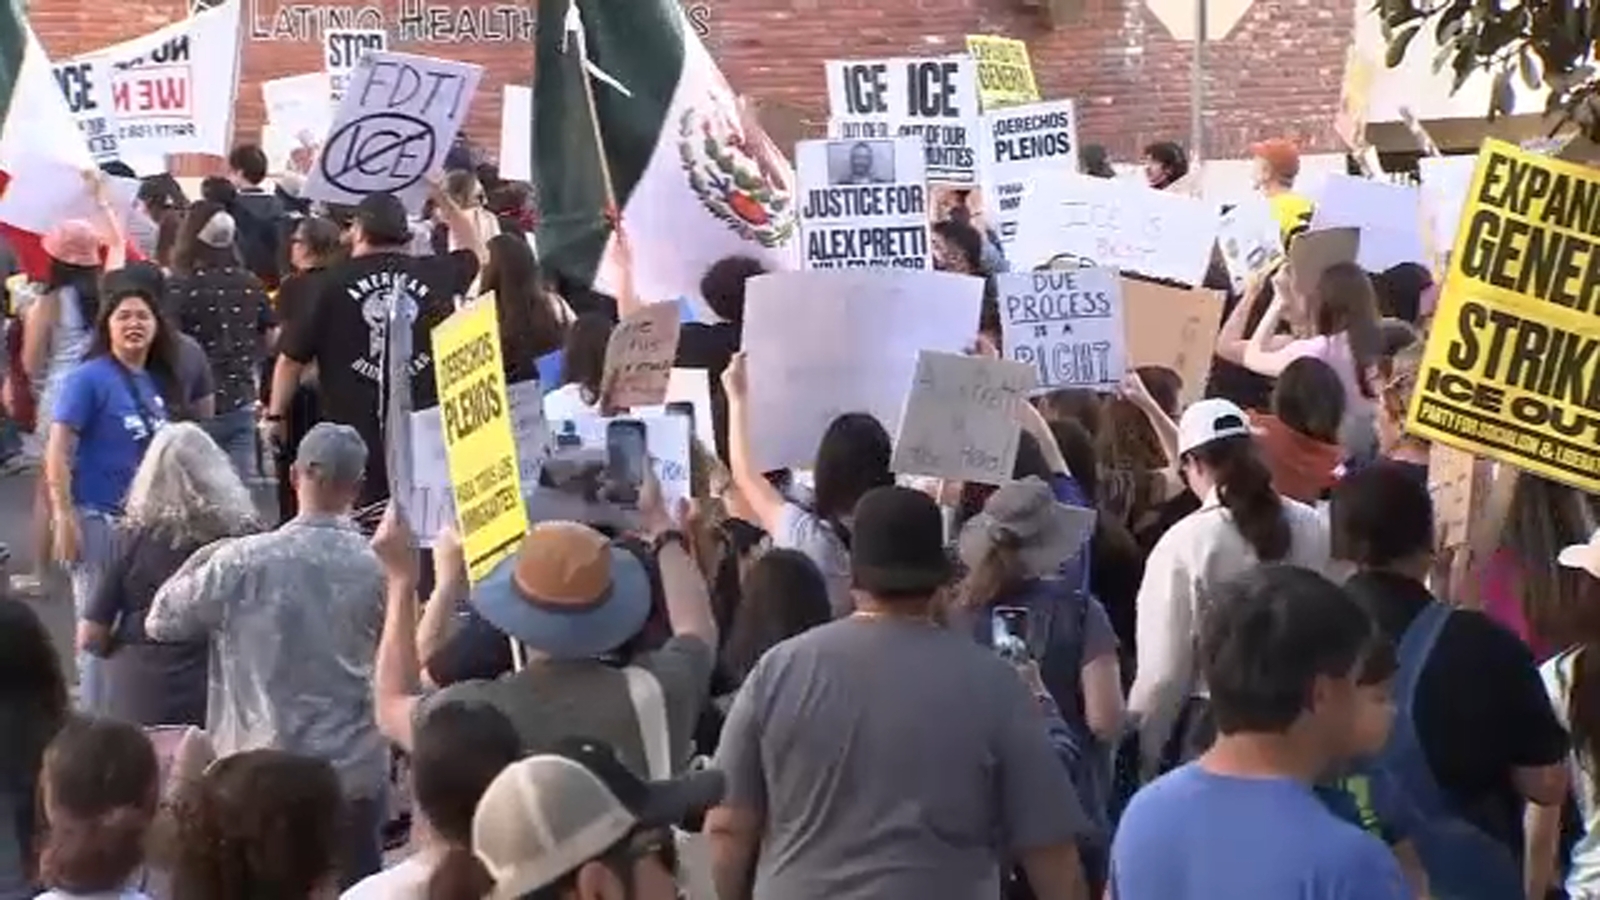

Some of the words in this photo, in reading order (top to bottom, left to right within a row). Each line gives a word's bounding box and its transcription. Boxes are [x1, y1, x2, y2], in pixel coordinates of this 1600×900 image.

[843, 64, 888, 114] ICE
[907, 62, 960, 118] ICE
[352, 124, 425, 179] ICE
[994, 132, 1071, 162] PLENOS
[803, 186, 884, 219] JUSTICE
[885, 184, 925, 214] FOR
[808, 228, 857, 260] ALEX
[858, 225, 928, 258] PRETTI
[1032, 271, 1079, 293] DUE
[1006, 291, 1111, 320] PROCESS
[1034, 324, 1048, 337] IS
[1062, 323, 1074, 336] A
[1424, 367, 1505, 413] ICE
[444, 372, 502, 446] PLENOS
